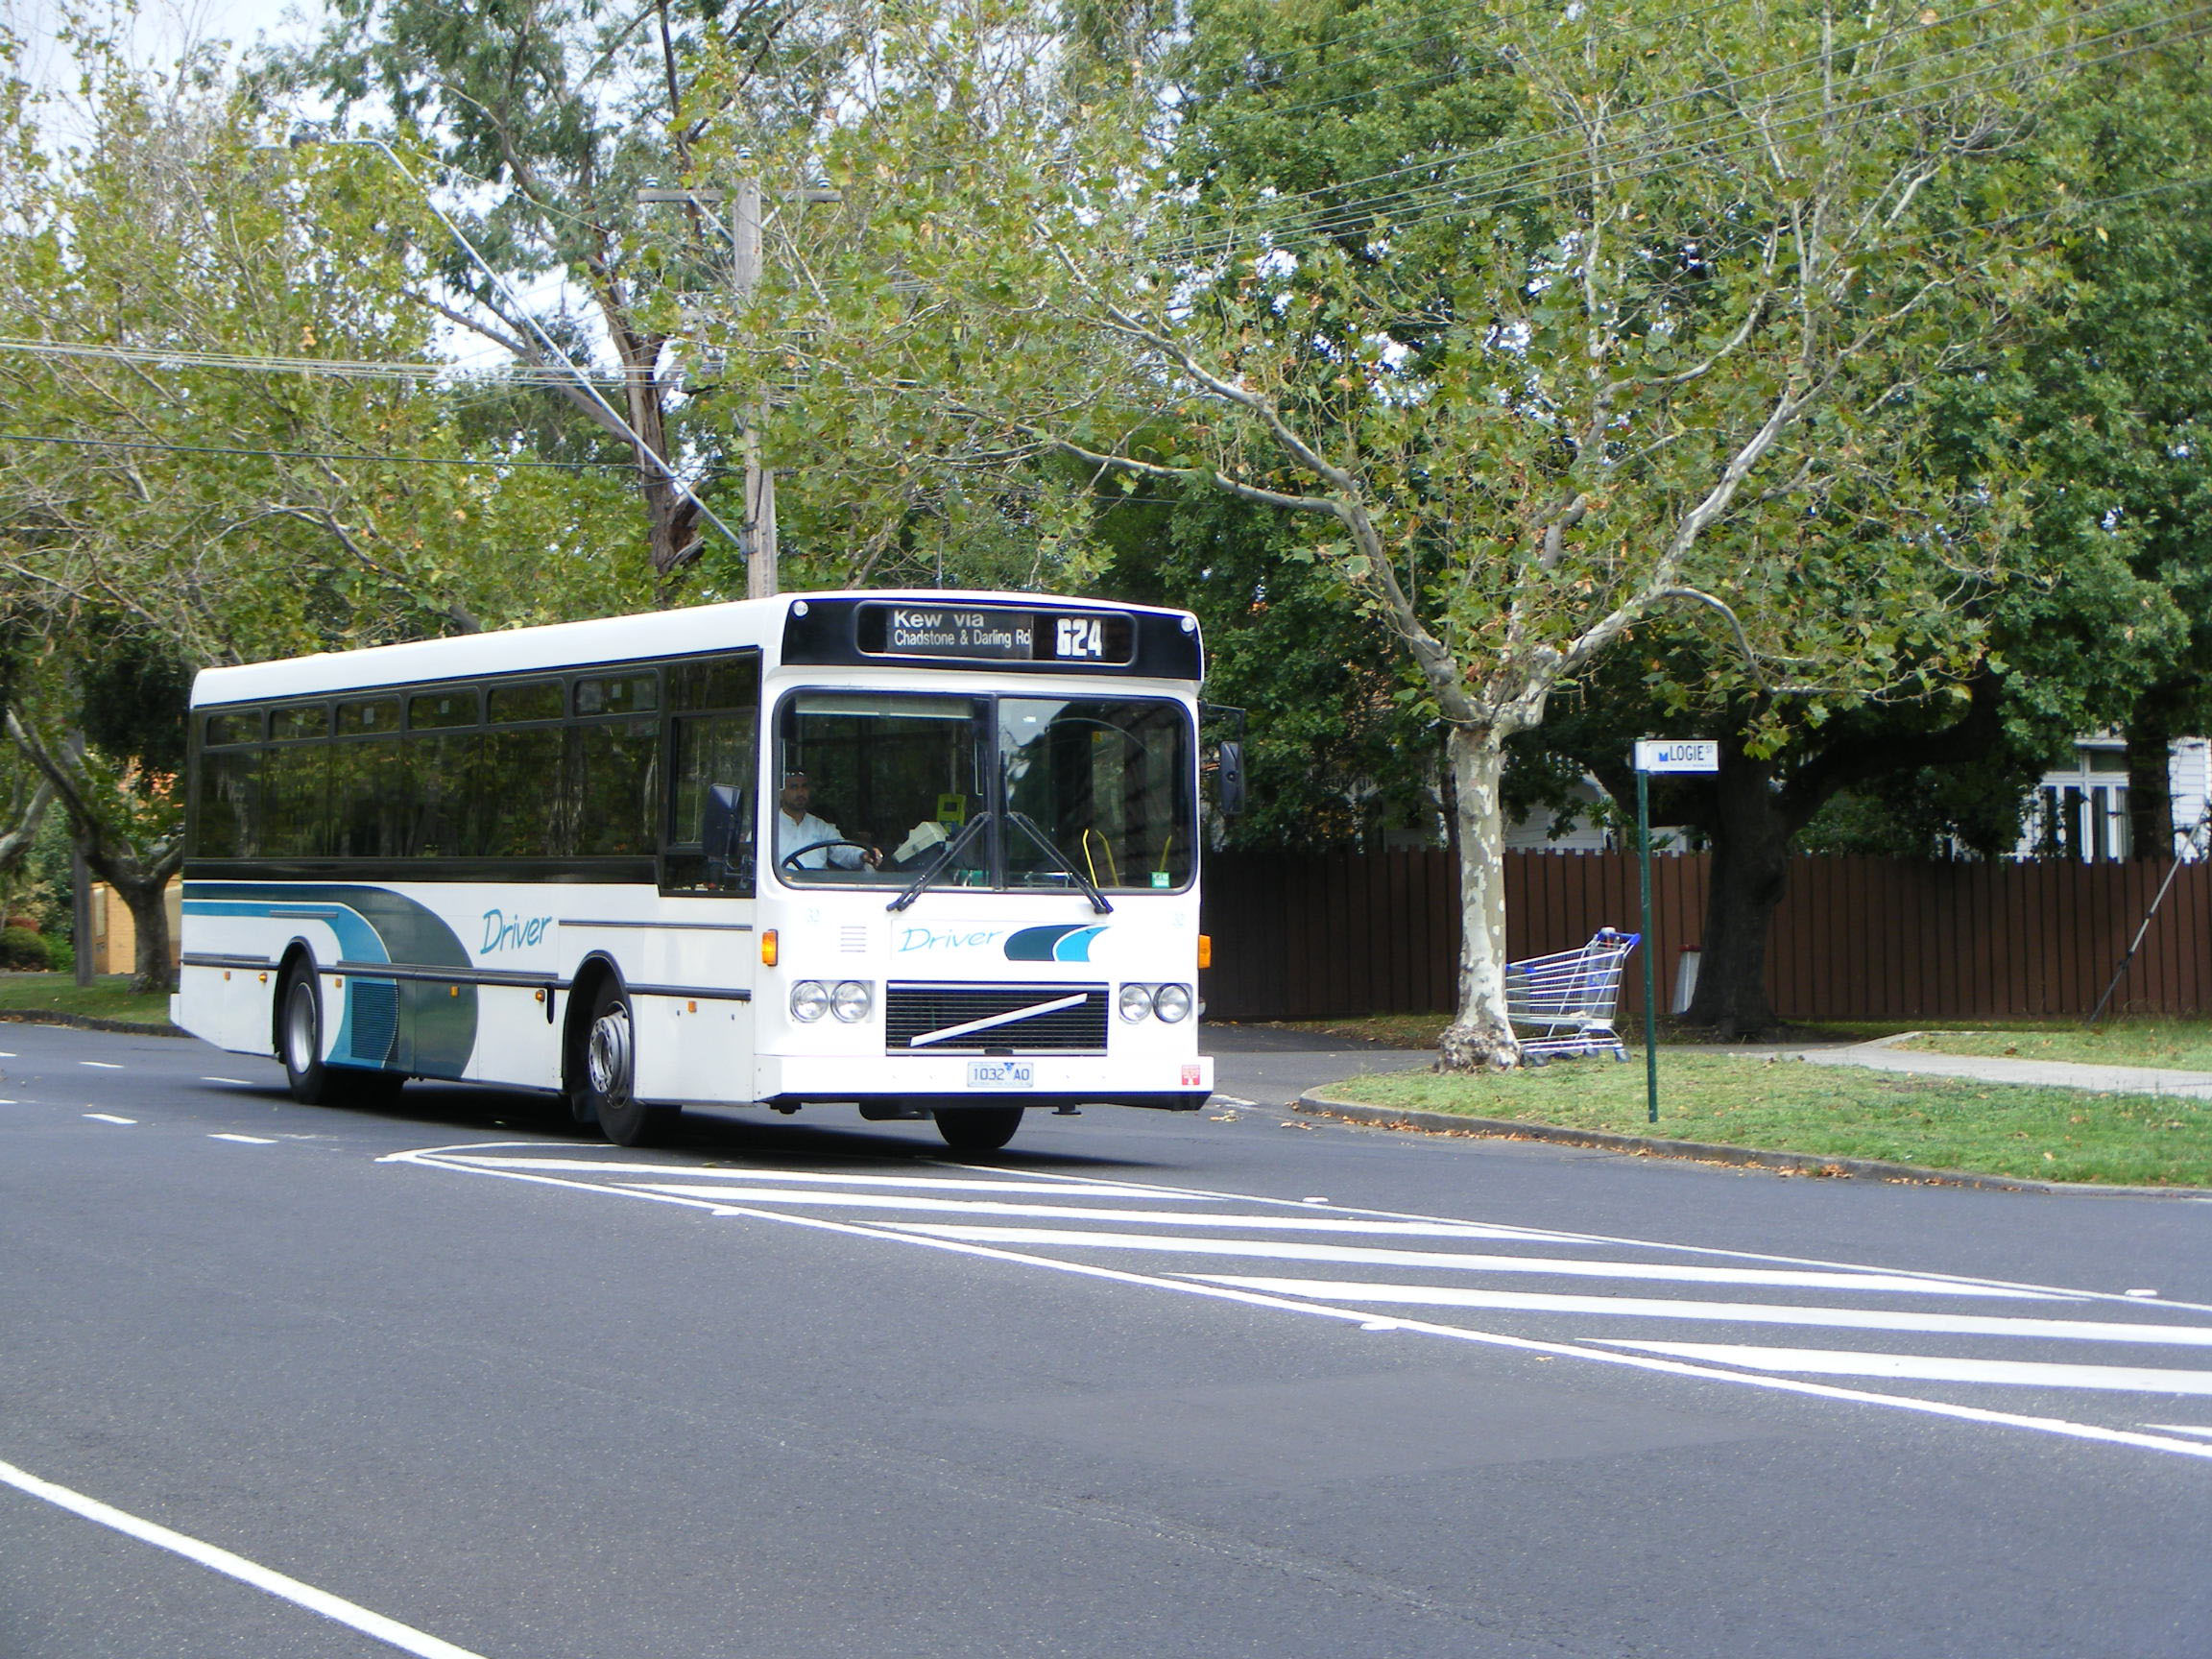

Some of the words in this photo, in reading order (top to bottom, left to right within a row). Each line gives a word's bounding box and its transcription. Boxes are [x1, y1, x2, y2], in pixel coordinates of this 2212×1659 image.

[893, 610, 943, 628] Kew
[953, 613, 984, 627] via
[894, 629, 955, 646] Chadstone
[960, 629, 969, 645] &
[973, 629, 1012, 648] Darling
[1016, 628, 1031, 645] Rd
[1056, 617, 1102, 657] 624
[1670, 745, 1704, 761] LOGIE
[480, 908, 553, 955] Driver
[898, 927, 1004, 952] Driver
[974, 1068, 1005, 1081] 1032
